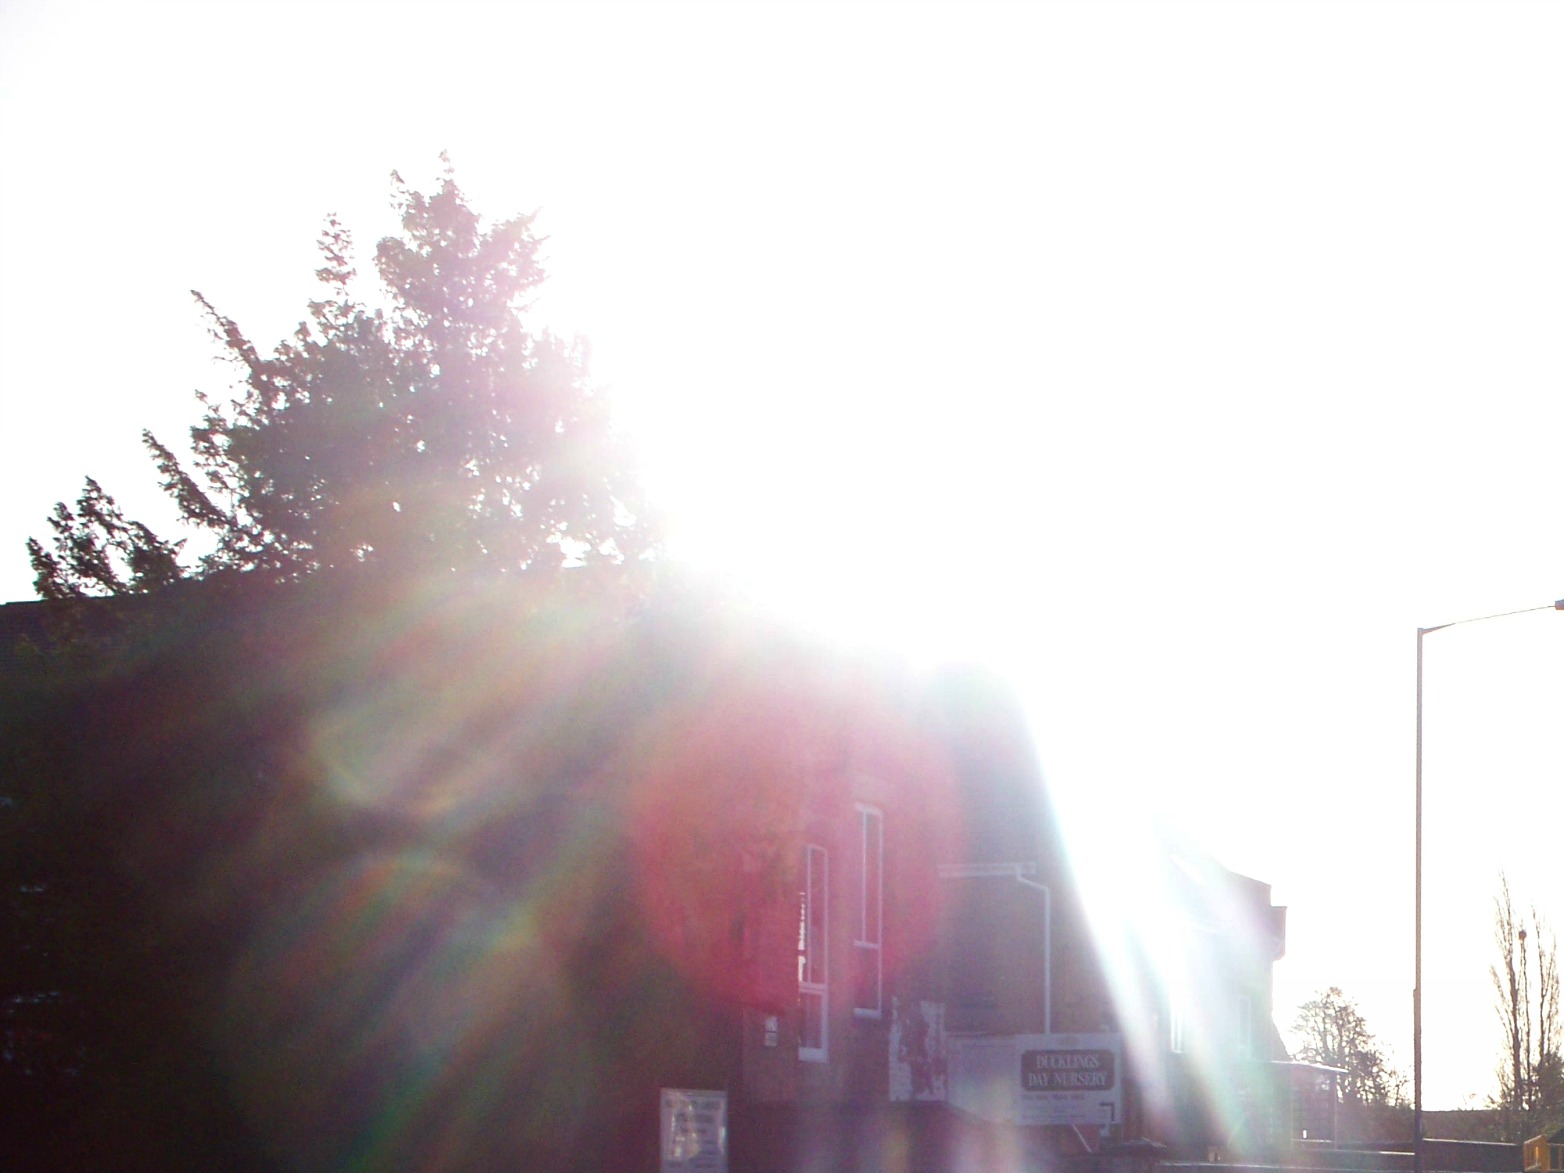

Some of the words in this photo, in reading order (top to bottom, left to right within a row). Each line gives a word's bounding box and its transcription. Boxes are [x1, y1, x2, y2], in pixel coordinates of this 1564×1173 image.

[1036, 1055, 1100, 1069] DUCKLINGS
[1028, 1072, 1049, 1086] DAY
[1053, 1072, 1107, 1087] NURSERY
